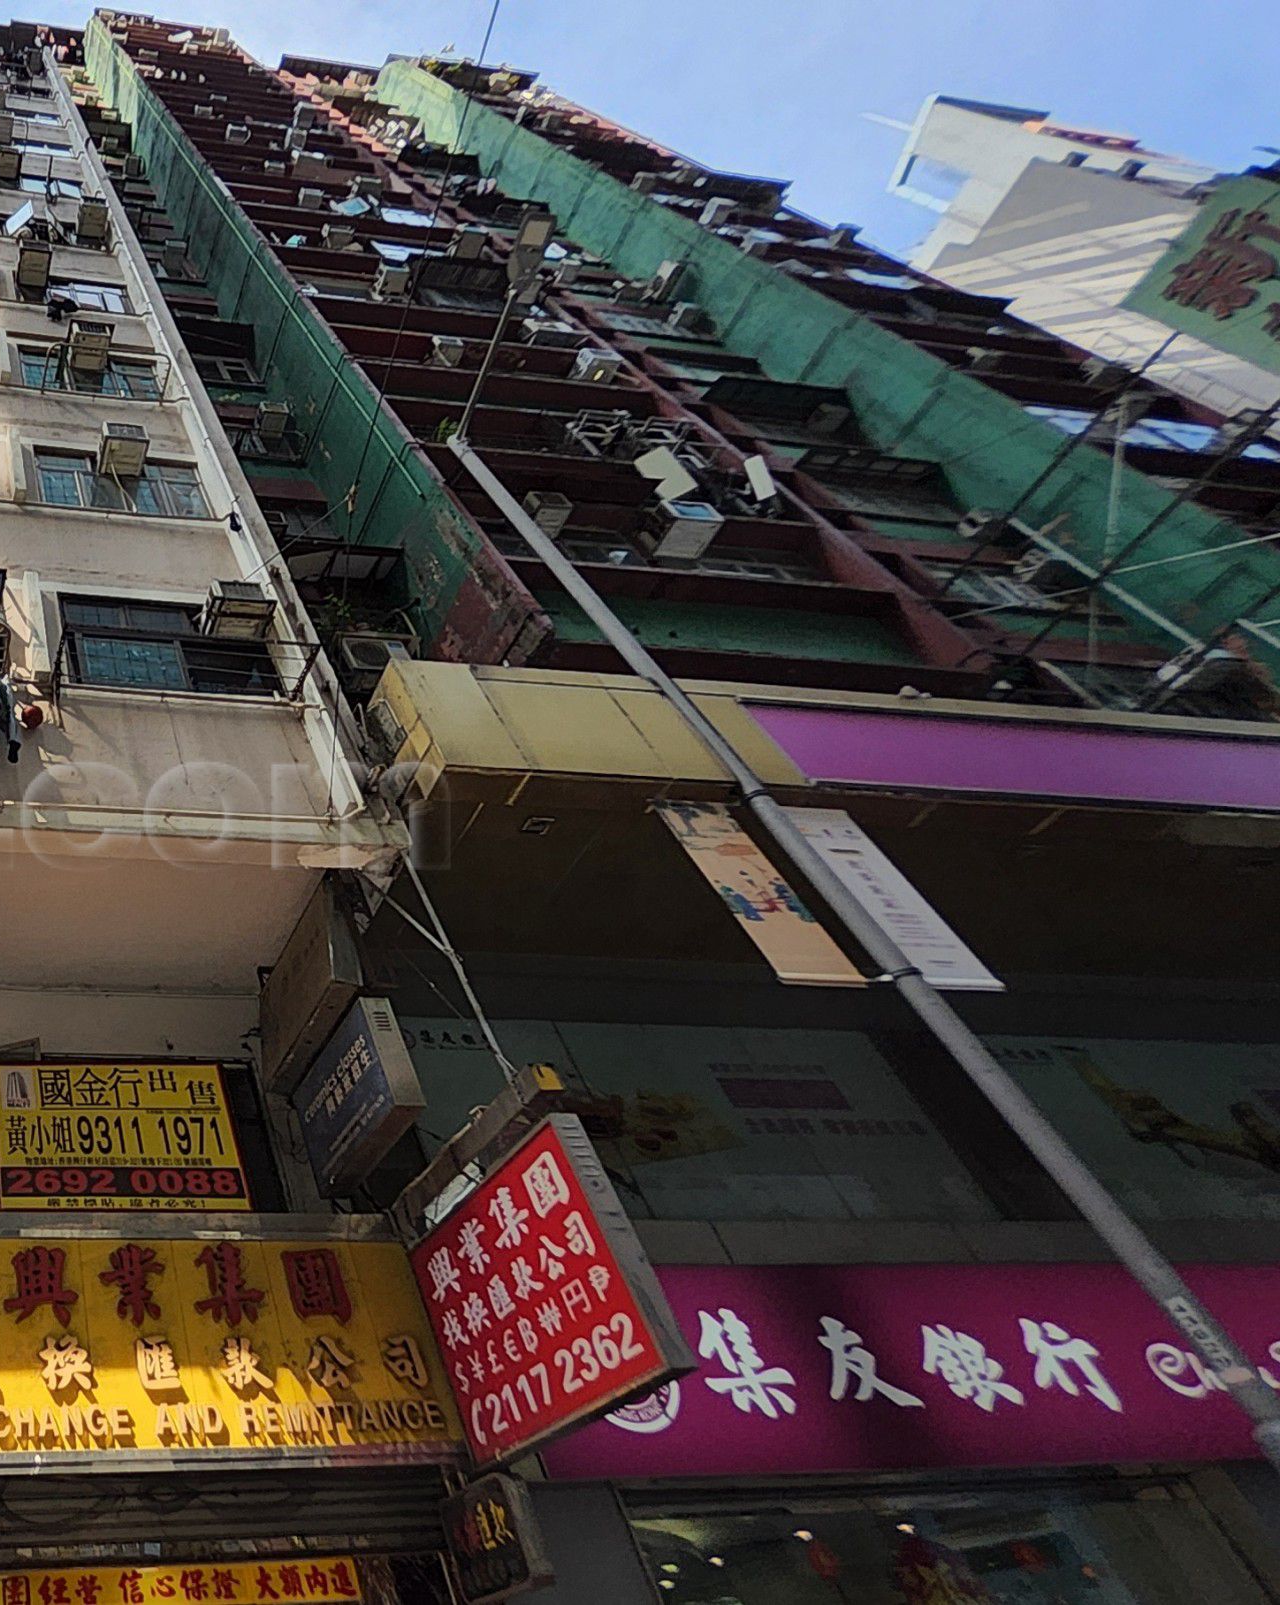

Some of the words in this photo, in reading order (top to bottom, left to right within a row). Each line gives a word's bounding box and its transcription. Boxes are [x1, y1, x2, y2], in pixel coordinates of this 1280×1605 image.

[5, 1115, 73, 1155] 黃小姐
[76, 1115, 144, 1154] 9311
[157, 1116, 224, 1155] 1971
[6, 1170, 118, 1194] 2692
[130, 1170, 239, 1195] 0088
[4, 1243, 352, 1328] 興業集團
[485, 1363, 553, 1434] 2117
[554, 1312, 645, 1394] 2362
[697, 1308, 1122, 1418] 集友銀行
[156, 1403, 224, 1435] AND
[239, 1400, 446, 1434] REMITTANCE
